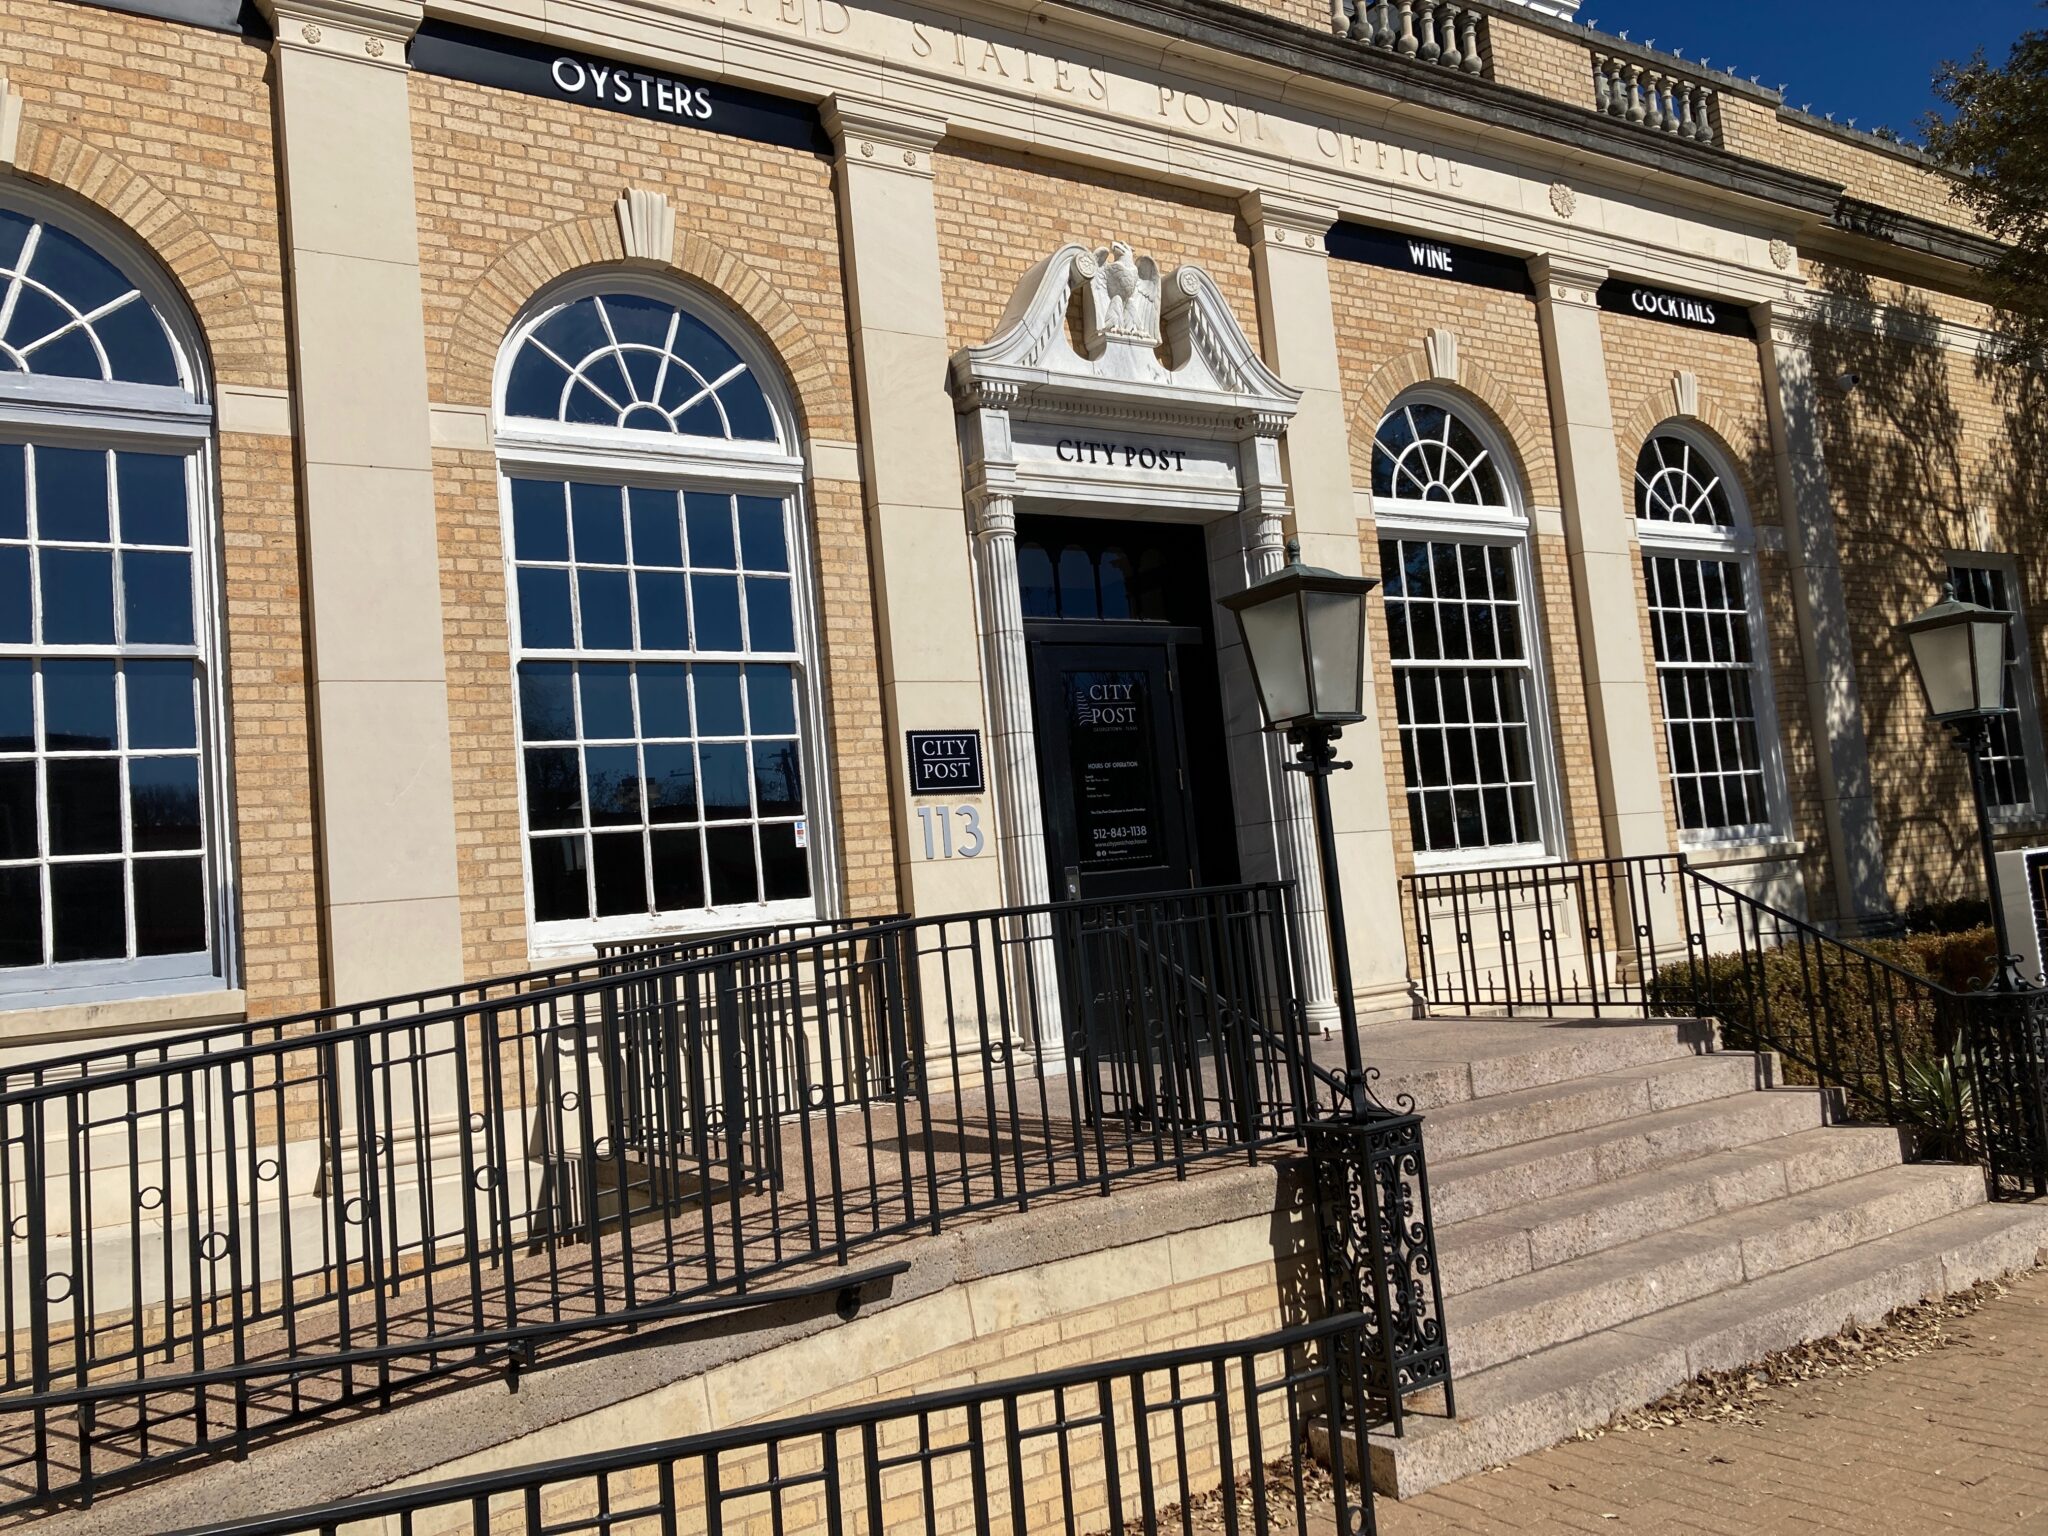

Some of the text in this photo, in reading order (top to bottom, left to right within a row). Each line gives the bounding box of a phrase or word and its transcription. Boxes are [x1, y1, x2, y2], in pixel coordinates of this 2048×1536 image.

[551, 57, 713, 119] OYSTERS
[911, 19, 1106, 101] STATES
[1156, 83, 1268, 141] POST
[1316, 124, 1464, 188] OFFICE
[1407, 240, 1454, 273] WINE
[1631, 288, 1716, 325] COCKTAILS
[1056, 439, 1186, 472] CITY POST
[1089, 684, 1133, 700] CITY
[1091, 706, 1136, 724] POST
[921, 739, 968, 756] CITY
[923, 761, 971, 779] POST
[917, 804, 985, 860] 113
[1093, 825, 1147, 840] 512-843-1138
